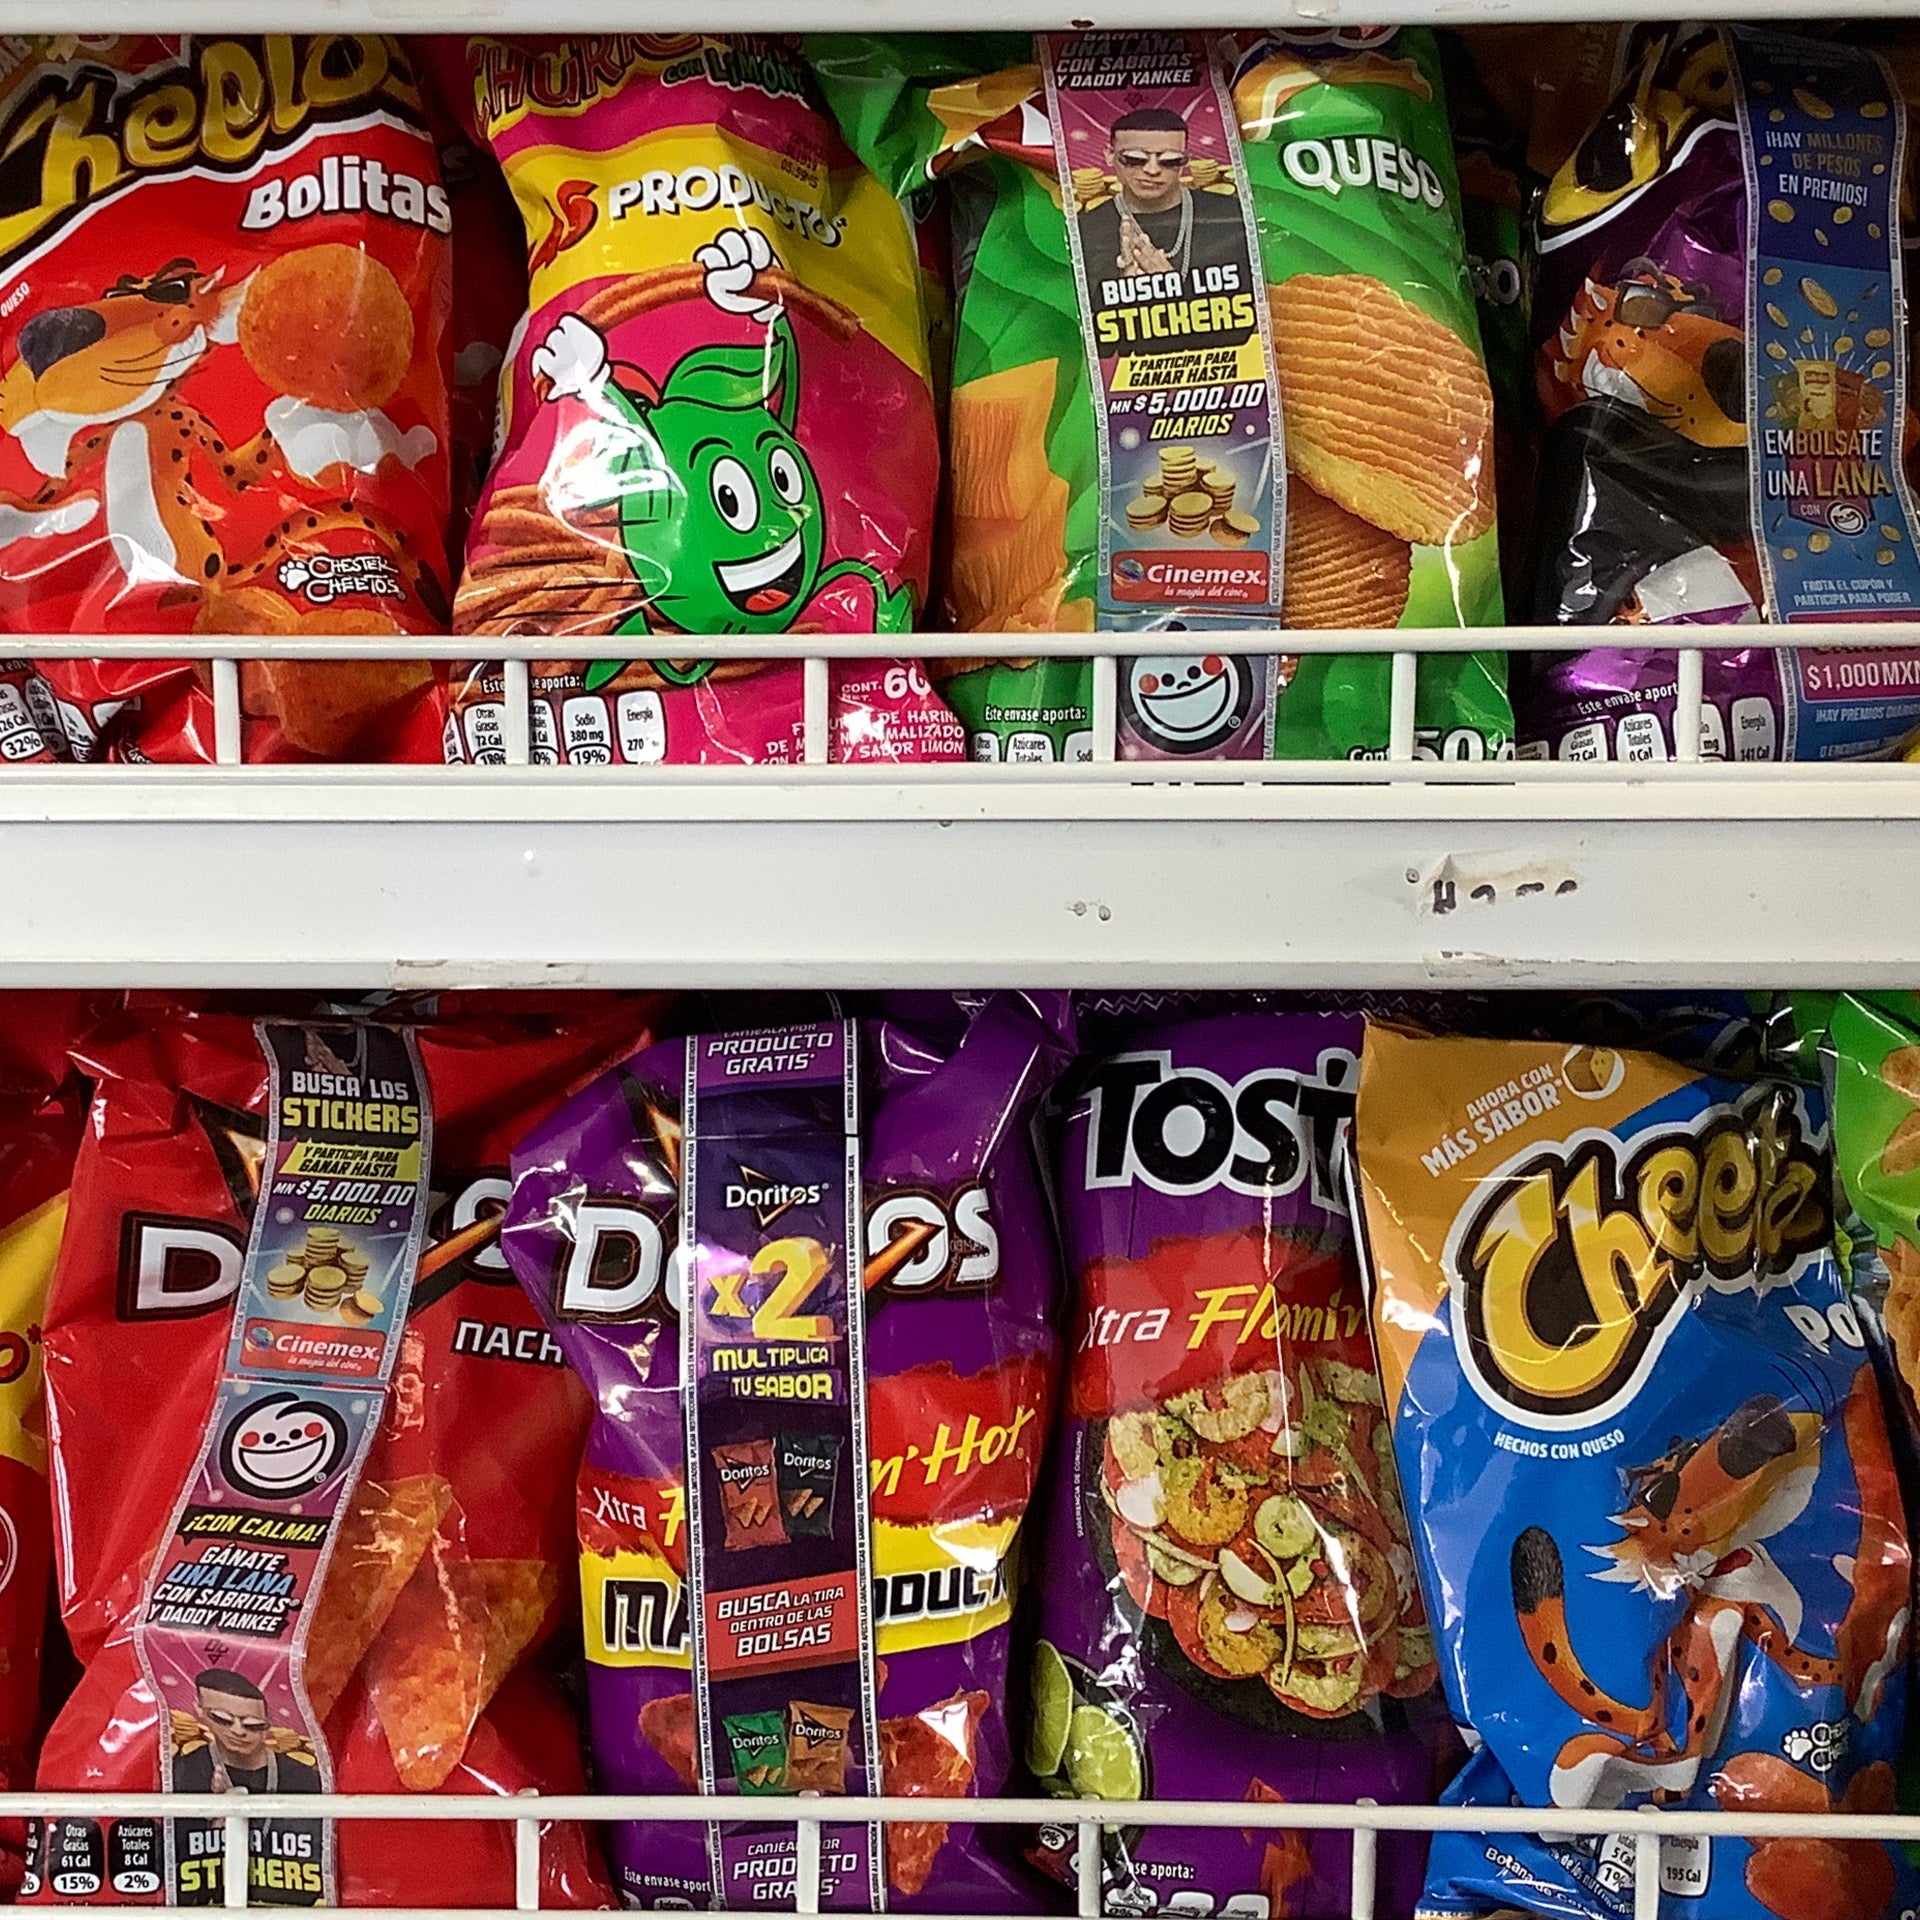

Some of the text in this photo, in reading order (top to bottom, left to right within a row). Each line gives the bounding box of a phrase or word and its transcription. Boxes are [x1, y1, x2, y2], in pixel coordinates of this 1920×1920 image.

[665, 59, 702, 82] CON
[1057, 52, 1192, 72] CON SABRITAS
[1056, 69, 1193, 87] Y DADDY YANKEE
[1764, 130, 1884, 154] ¡HAY MILLONES
[1283, 138, 1446, 209] QUESO
[1791, 152, 1862, 178] DE PESOS
[242, 155, 452, 234] Bolitas
[1778, 173, 1869, 208] EN PREMIOS!
[607, 165, 842, 248] PRODUCTO
[1101, 264, 1240, 306] BUSCA LOS
[0, 283, 30, 317] QUESO
[1096, 293, 1256, 343] STICKERS
[1129, 350, 1237, 371] Y PARTICIPA PARA
[1129, 364, 1238, 387] GANAR HASTA
[1109, 383, 1266, 416] MN $5,000.00
[1149, 413, 1234, 440] DIARIOS
[1765, 429, 1884, 457] EMBOLSATE
[1768, 460, 1893, 497] UNA LANA
[1800, 503, 1821, 517] CON
[308, 556, 399, 579] CHESTER
[1147, 564, 1261, 584] Cinemex
[306, 575, 401, 602] CHEETOS
[1802, 579, 1849, 592] FROTA EL
[1793, 589, 1912, 607] PARTICIPA PARA PODER
[482, 674, 580, 693] Este aporta:
[841, 680, 883, 694] CONT.
[1806, 661, 1880, 692] $1,000
[1577, 690, 1642, 716] Este envase
[1840, 705, 1885, 722] PREMIOS
[575, 714, 597, 727] Sodio
[985, 706, 1087, 725] Este envase aporta:
[6, 734, 41, 756] 32%
[475, 733, 503, 746] 72 Cal
[570, 730, 605, 744] 380 mg
[627, 738, 645, 751] 270
[766, 739, 789, 755] DE
[858, 740, 914, 758] SABOR
[921, 736, 964, 755] LIMÓN
[1012, 736, 1047, 750] Azúcares
[1703, 739, 1719, 751] mg
[574, 749, 607, 764] 19%
[1582, 747, 1598, 760] Cal
[1637, 747, 1653, 760] Cal
[707, 1032, 833, 1057] PRODUCTO
[726, 1053, 808, 1076] GRATIS
[291, 1071, 410, 1101] BUSCA LOS
[1465, 1062, 1555, 1120] AHORA CON
[282, 1097, 420, 1134] STICKERS
[1419, 1081, 1562, 1178] MÁS SABOR
[303, 1146, 400, 1163] Y PARTICIPA PARA
[298, 1159, 398, 1178] GANAR HASTA
[272, 1179, 416, 1206] MN $5,000.00
[726, 1183, 821, 1208] Doritos
[303, 1203, 383, 1224] DIARIOS
[708, 1236, 836, 1343] x2
[1077, 1304, 1171, 1354] Xtra
[275, 1335, 378, 1360] Cinemex
[454, 1320, 564, 1364] NACH
[712, 1346, 829, 1373] MULTIPLICA
[732, 1373, 834, 1401] TU SABOR
[919, 1404, 1036, 1486] Hot
[1494, 1429, 1626, 1459] HECHOS CON QUESO
[721, 1464, 770, 1482] Doritos
[783, 1452, 832, 1471] Doritos
[1073, 1430, 1085, 1538] SUGERENCIA CONSUMO
[592, 1486, 648, 1531] Xtra
[184, 1513, 328, 1543] ¡CON CALMA!
[199, 1542, 286, 1572] GÁNATE
[166, 1561, 295, 1597] UNA LANA
[152, 1583, 290, 1615] CON SABRITAS
[717, 1586, 845, 1620] BUSCA LA TIRA
[147, 1603, 284, 1633] Y DADDY YANKEE
[730, 1605, 833, 1634] DENTRO DE LAS
[737, 1623, 833, 1657] BOLSAS
[732, 1733, 780, 1751] Doritos
[794, 1723, 842, 1741] Doritos
[64, 1823, 87, 1838] Otras
[117, 1824, 154, 1838] Azúcares
[62, 1837, 89, 1854] Grasas
[121, 1839, 151, 1853] Totales
[270, 1831, 312, 1858] LOS
[61, 1854, 91, 1869] 61 Cal
[132, 1854, 148, 1867] Cal
[1485, 1846, 1534, 1884] Botana
[1561, 1853, 1574, 1869] de
[1611, 1847, 1635, 1868] 5 Cal
[60, 1875, 95, 1890] 15%
[123, 1874, 150, 1889] 2%
[180, 1857, 322, 1892] STKERS
[643, 1876, 681, 1889] envase
[1150, 1864, 1195, 1880] aporta:
[1604, 1866, 1627, 1888] 1%
[1666, 1867, 1702, 1882] 195 Cal
